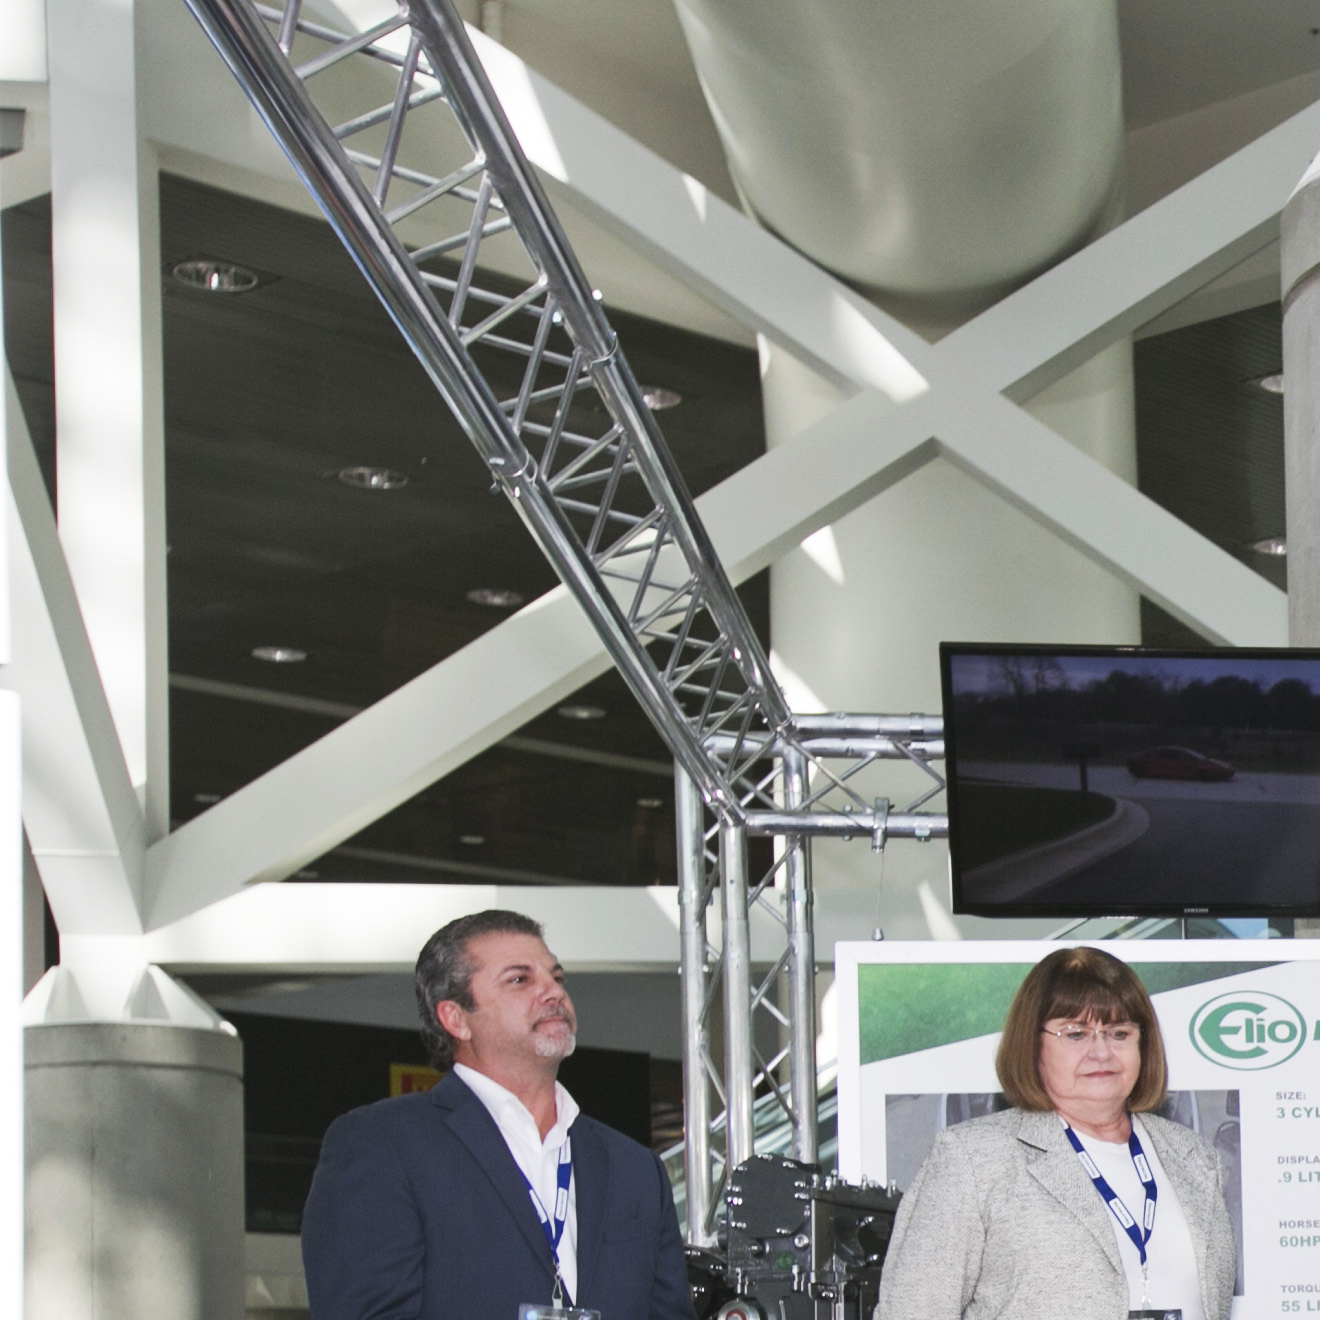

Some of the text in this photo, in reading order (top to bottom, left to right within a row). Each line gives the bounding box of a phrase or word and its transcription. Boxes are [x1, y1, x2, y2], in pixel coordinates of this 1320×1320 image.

[1199, 1002, 1298, 1059] Elio
[1276, 1092, 1306, 1100] SIZE:
[1276, 1107, 1286, 1118] 3
[1278, 1171, 1292, 1183] .9
[1281, 1301, 1301, 1312] 55
